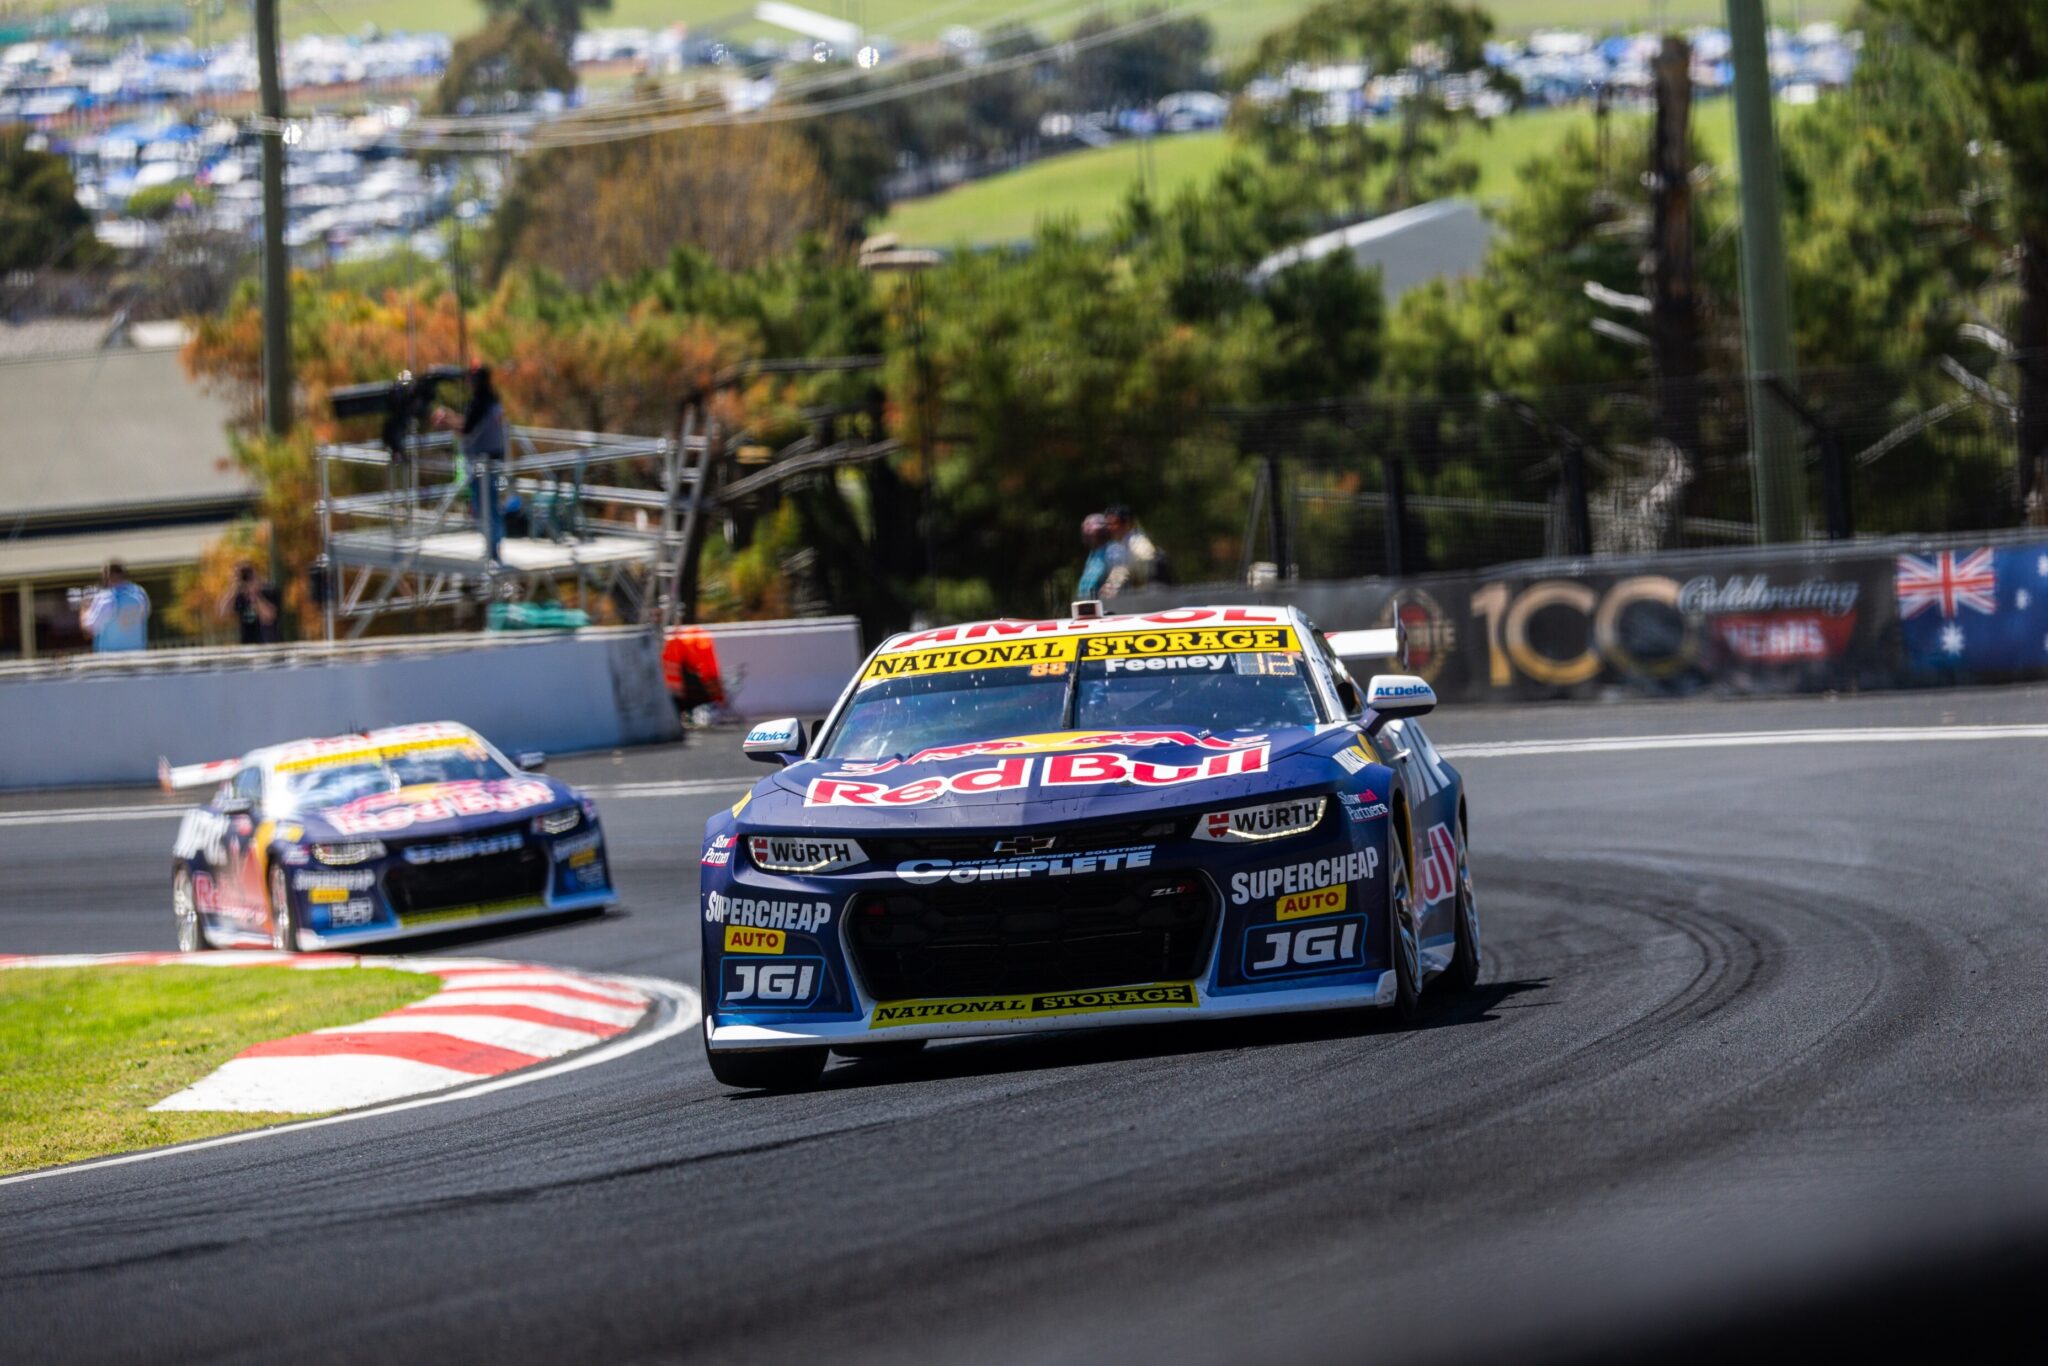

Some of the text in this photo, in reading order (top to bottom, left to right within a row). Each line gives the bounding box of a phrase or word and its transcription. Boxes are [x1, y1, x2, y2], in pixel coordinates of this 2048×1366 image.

[891, 609, 1277, 650] AMOL
[871, 630, 1280, 677] NATIONAL STORAGE
[1030, 661, 1067, 677] 88
[1105, 654, 1228, 673] Feeney
[803, 742, 1271, 808] Red Bull
[1233, 801, 1318, 832] WÜRTH
[1344, 803, 1389, 820] Partners
[770, 842, 852, 864] WÜRTH
[1084, 844, 1156, 857] SOLUTIONS
[1231, 846, 1379, 905] SUPERCHEAP
[705, 890, 831, 934] SUPERCHEAP
[1283, 891, 1340, 914] AUTO
[730, 932, 779, 948] AUTO
[1253, 922, 1358, 971] JGI
[725, 964, 815, 1001] JGI
[875, 987, 1186, 1022] NATIONAL STORAGE
